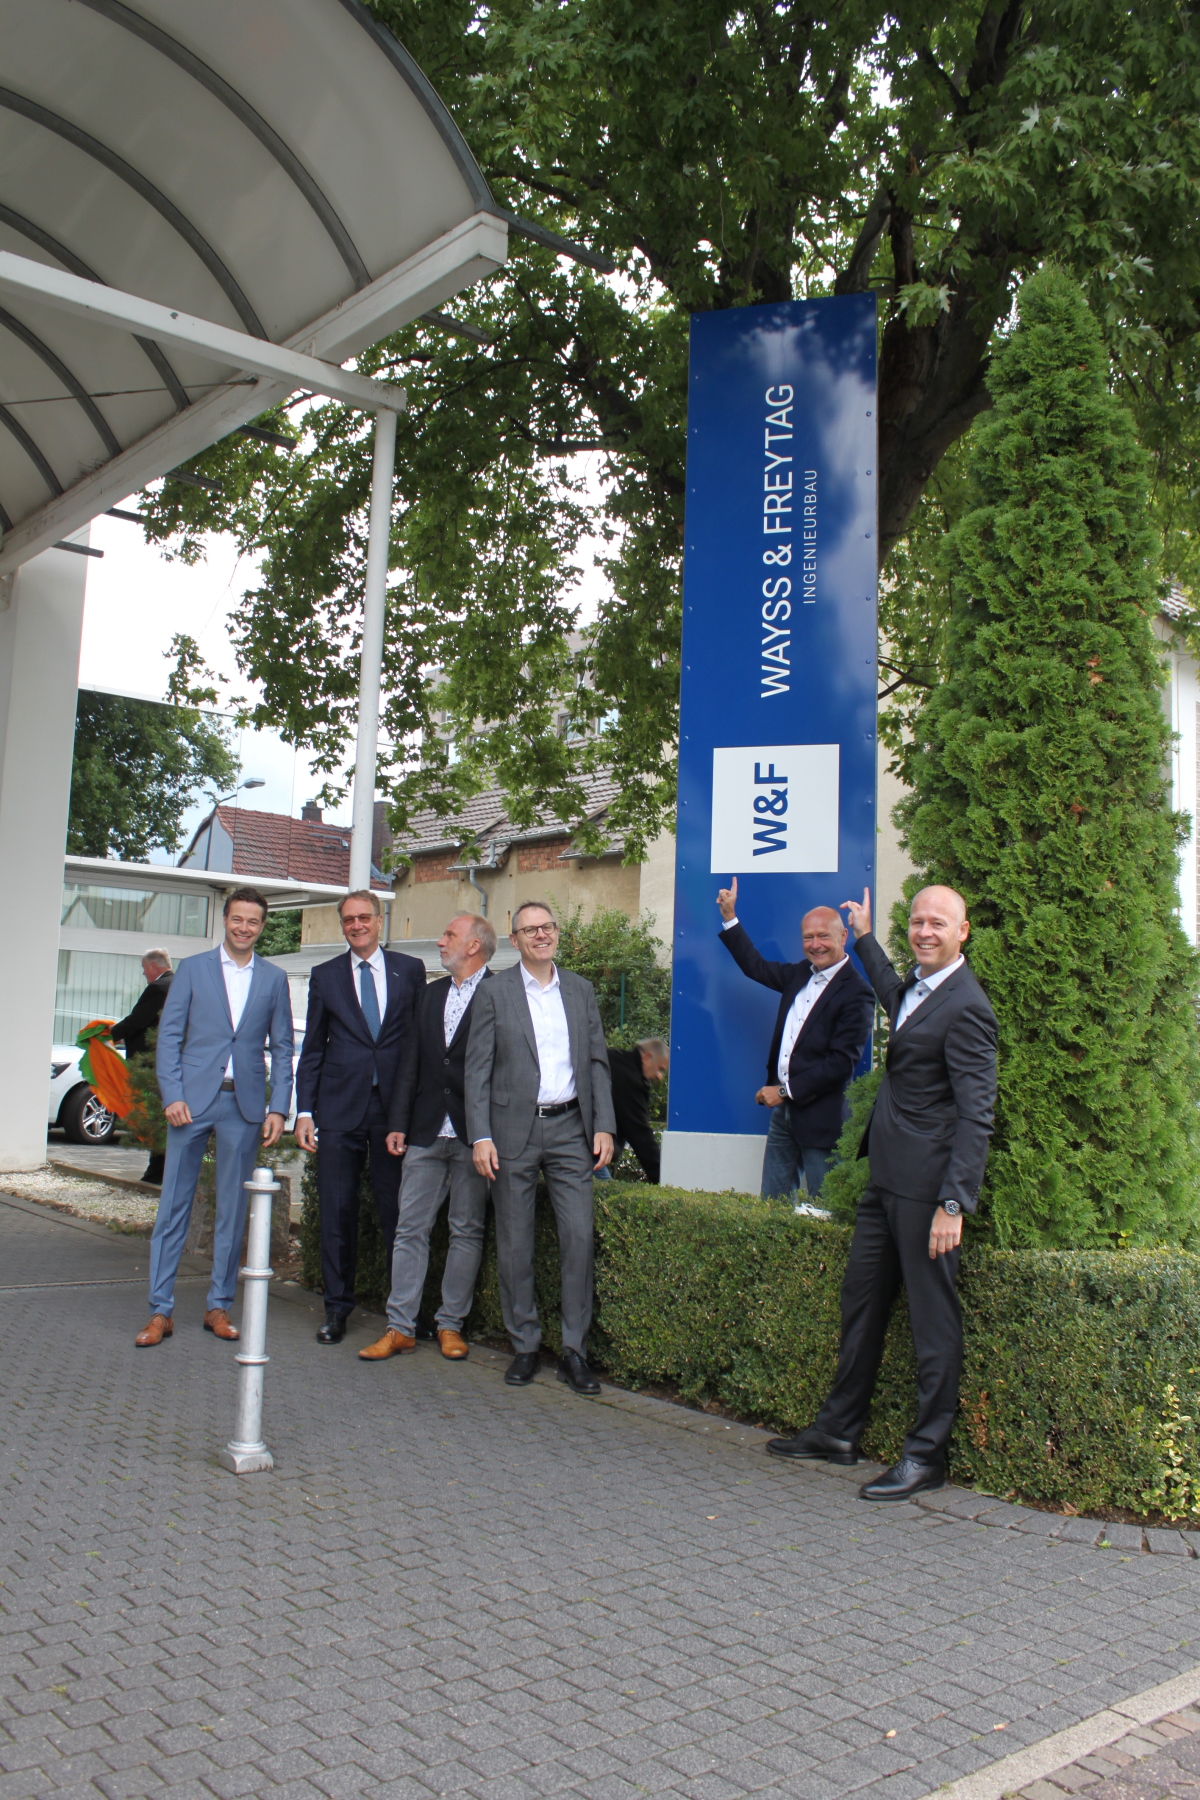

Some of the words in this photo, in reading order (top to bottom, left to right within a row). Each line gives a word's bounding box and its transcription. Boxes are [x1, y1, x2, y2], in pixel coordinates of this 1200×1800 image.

[763, 384, 794, 534] FREYTAG
[763, 543, 792, 566] &
[803, 469, 817, 604] INGENIEURBAU
[761, 577, 791, 698] WAYSS
[753, 762, 788, 857] W&F
